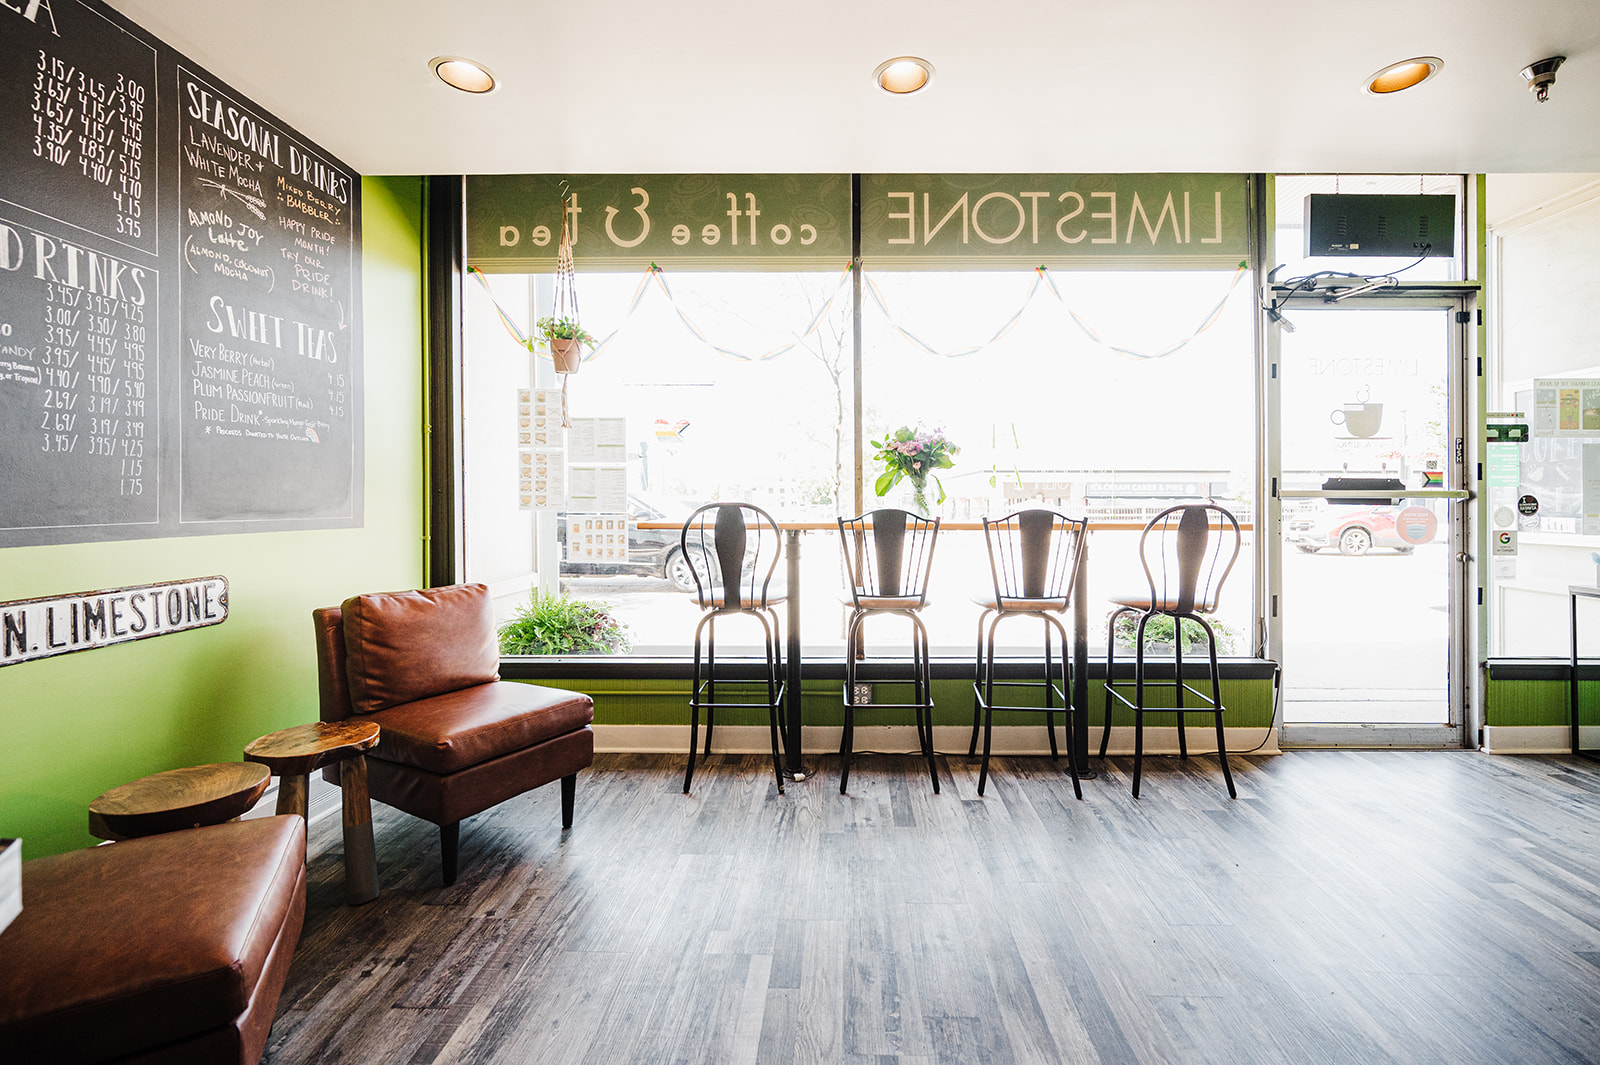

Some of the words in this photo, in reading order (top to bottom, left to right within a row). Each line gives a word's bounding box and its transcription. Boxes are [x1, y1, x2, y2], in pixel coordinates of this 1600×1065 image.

[37, 50, 75, 83] 3.15/
[78, 72, 116, 106] 3.65/
[119, 95, 144, 122] 3.95
[116, 73, 145, 104] 3.00
[33, 72, 71, 104] 3.65/
[78, 92, 115, 125] 4.15/
[119, 114, 142, 142] 4.45
[31, 91, 73, 126] 3.65/
[80, 114, 114, 146] 4.15/
[121, 135, 142, 160] 4.45
[186, 81, 284, 169] SEASONAL
[289, 145, 347, 204] DRINKS
[33, 113, 73, 146] 4.35/
[78, 135, 115, 167] 4.85/
[119, 154, 141, 180] 5.15
[184, 145, 226, 179] WHITE
[189, 125, 255, 172] LAVENDER
[33, 135, 71, 166] 3.90/
[79, 156, 113, 186] 4.40/
[119, 174, 142, 199] 4.70
[113, 191, 141, 218] 4.15
[306, 190, 341, 215] BERRY
[116, 214, 141, 238] 3.95
[188, 208, 233, 228] ALMOND
[237, 222, 264, 246] JOY
[208, 227, 249, 252] Latte
[278, 216, 306, 236] HAPPY
[310, 226, 336, 245] PRIDE
[280, 248, 299, 263] TRY
[304, 256, 325, 270] OUR
[294, 238, 330, 256] MONTH!
[0, 223, 146, 306] DRINKS
[214, 263, 249, 281] MOCHA
[294, 263, 331, 285] PRIDE
[46, 283, 82, 307] 3.45/
[85, 293, 119, 316] 3.95/
[121, 302, 144, 324] 4.25
[292, 279, 333, 302] DRINK!
[45, 305, 81, 326] 3.00/
[88, 314, 117, 336] 3.50/
[124, 323, 146, 343] 3.80
[207, 295, 284, 349] SWEET
[293, 320, 337, 364] TEAS
[45, 325, 80, 347] 3.95/
[87, 333, 118, 356] 4.45/
[124, 341, 145, 362] 4.95
[42, 346, 79, 368] 3.95/
[87, 354, 116, 375] 4.45/
[123, 360, 145, 381] 4.95
[189, 338, 217, 358] VERY
[219, 343, 248, 366] BERRY
[328, 372, 345, 388] 4.15
[46, 368, 80, 389] 4.40/
[88, 374, 120, 395] 4.90/
[125, 380, 145, 399] 5.40
[192, 361, 239, 384] JASMINE
[242, 369, 270, 390] PEACH
[328, 389, 345, 404] 4.15
[193, 379, 223, 399] PLUM
[226, 383, 295, 409] PASSIONFRUIT
[329, 406, 345, 417] 4.15
[44, 389, 78, 410] 2.69/
[88, 395, 119, 414] 3.19/
[125, 400, 145, 417] 3.49
[194, 401, 225, 422] PRIDE
[41, 411, 76, 432] 2.69/
[90, 418, 119, 435] 3.19/
[126, 421, 144, 438] 3.49
[42, 433, 79, 453] 3.45/
[88, 436, 117, 456] 3.95/
[121, 439, 144, 458] 4.25
[121, 459, 143, 476] 1.15
[120, 479, 143, 496] 1.75
[3, 610, 38, 657] N.
[46, 582, 217, 650] LIMESTONE
